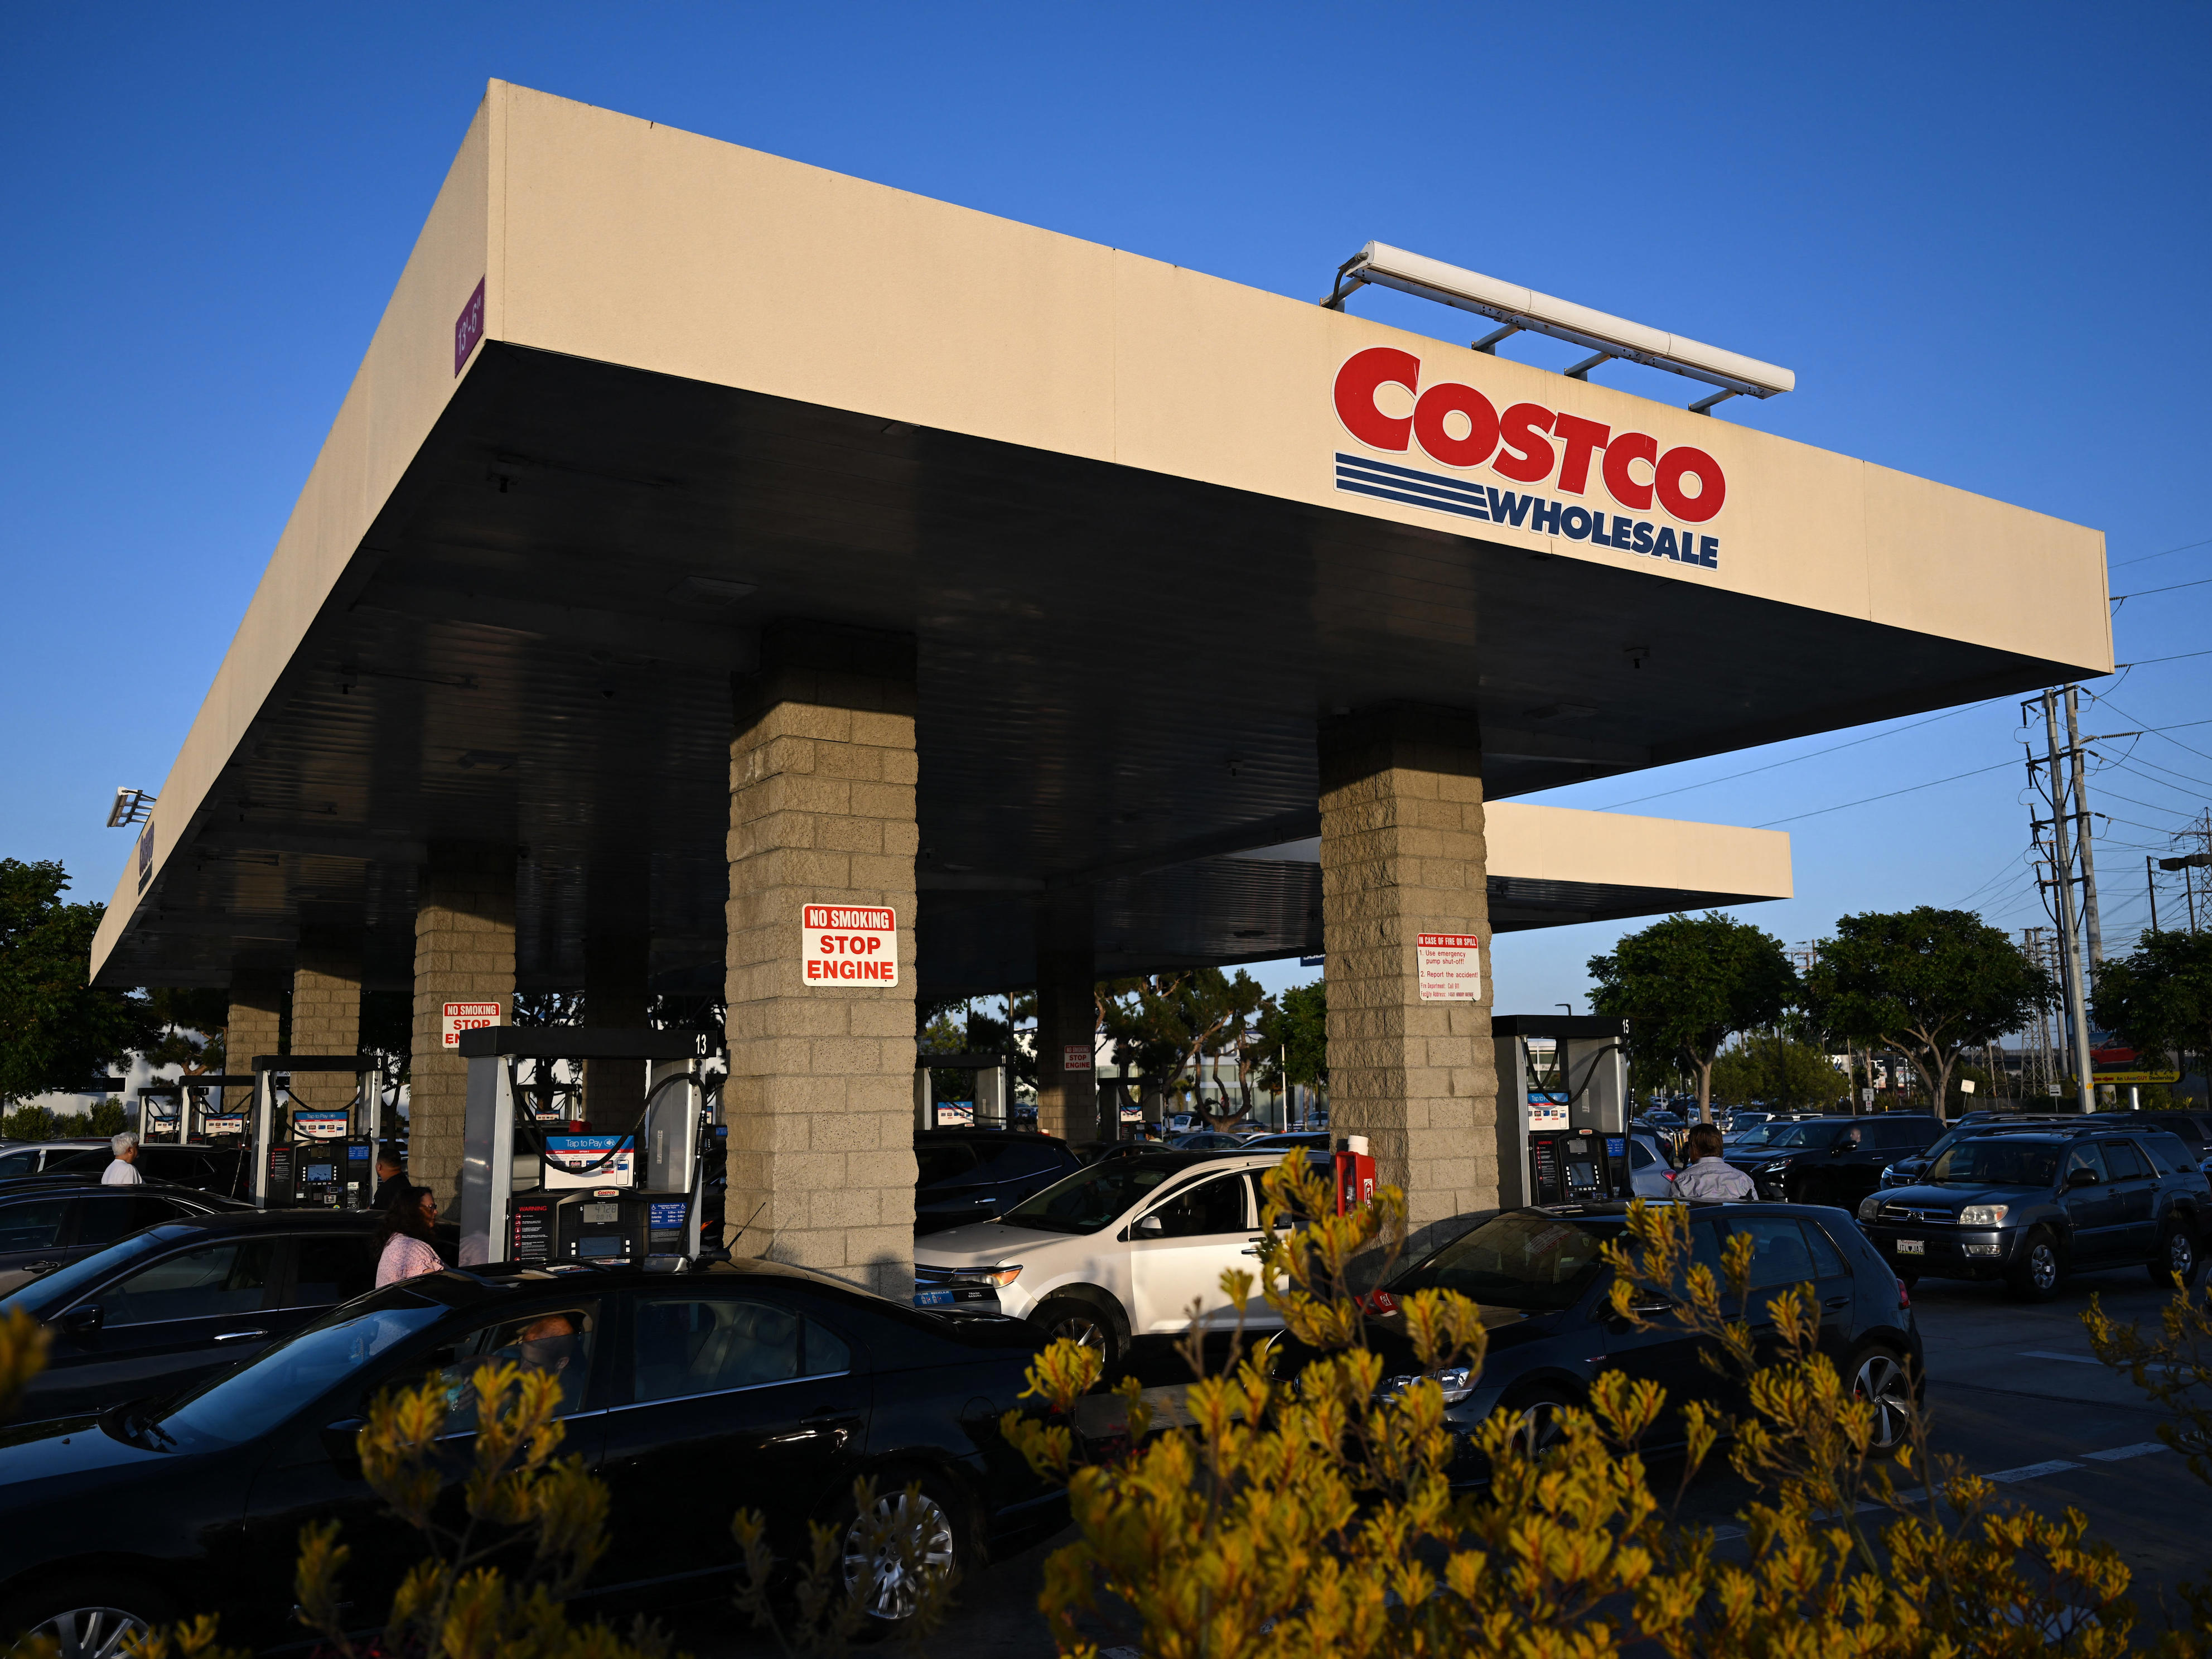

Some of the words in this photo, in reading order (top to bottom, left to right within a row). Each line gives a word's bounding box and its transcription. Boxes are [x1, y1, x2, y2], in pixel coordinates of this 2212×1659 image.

[1334, 346, 1726, 523] COSTCO
[1486, 487, 1719, 570] WHOLESALE
[810, 909, 827, 927] NO
[831, 910, 890, 929] SMOKING
[820, 935, 881, 954] STOP
[1424, 937, 1437, 945] CASE
[808, 960, 894, 980] ENGINE
[447, 1005, 458, 1015] NO
[460, 1005, 496, 1015] SMOKING
[453, 1019, 490, 1030] STOP
[1622, 1019, 1629, 1034] 15
[696, 1034, 706, 1054] 13
[378, 1057, 381, 1069] 9
[566, 1139, 579, 1148] Tap
[589, 1139, 602, 1147] Pay
